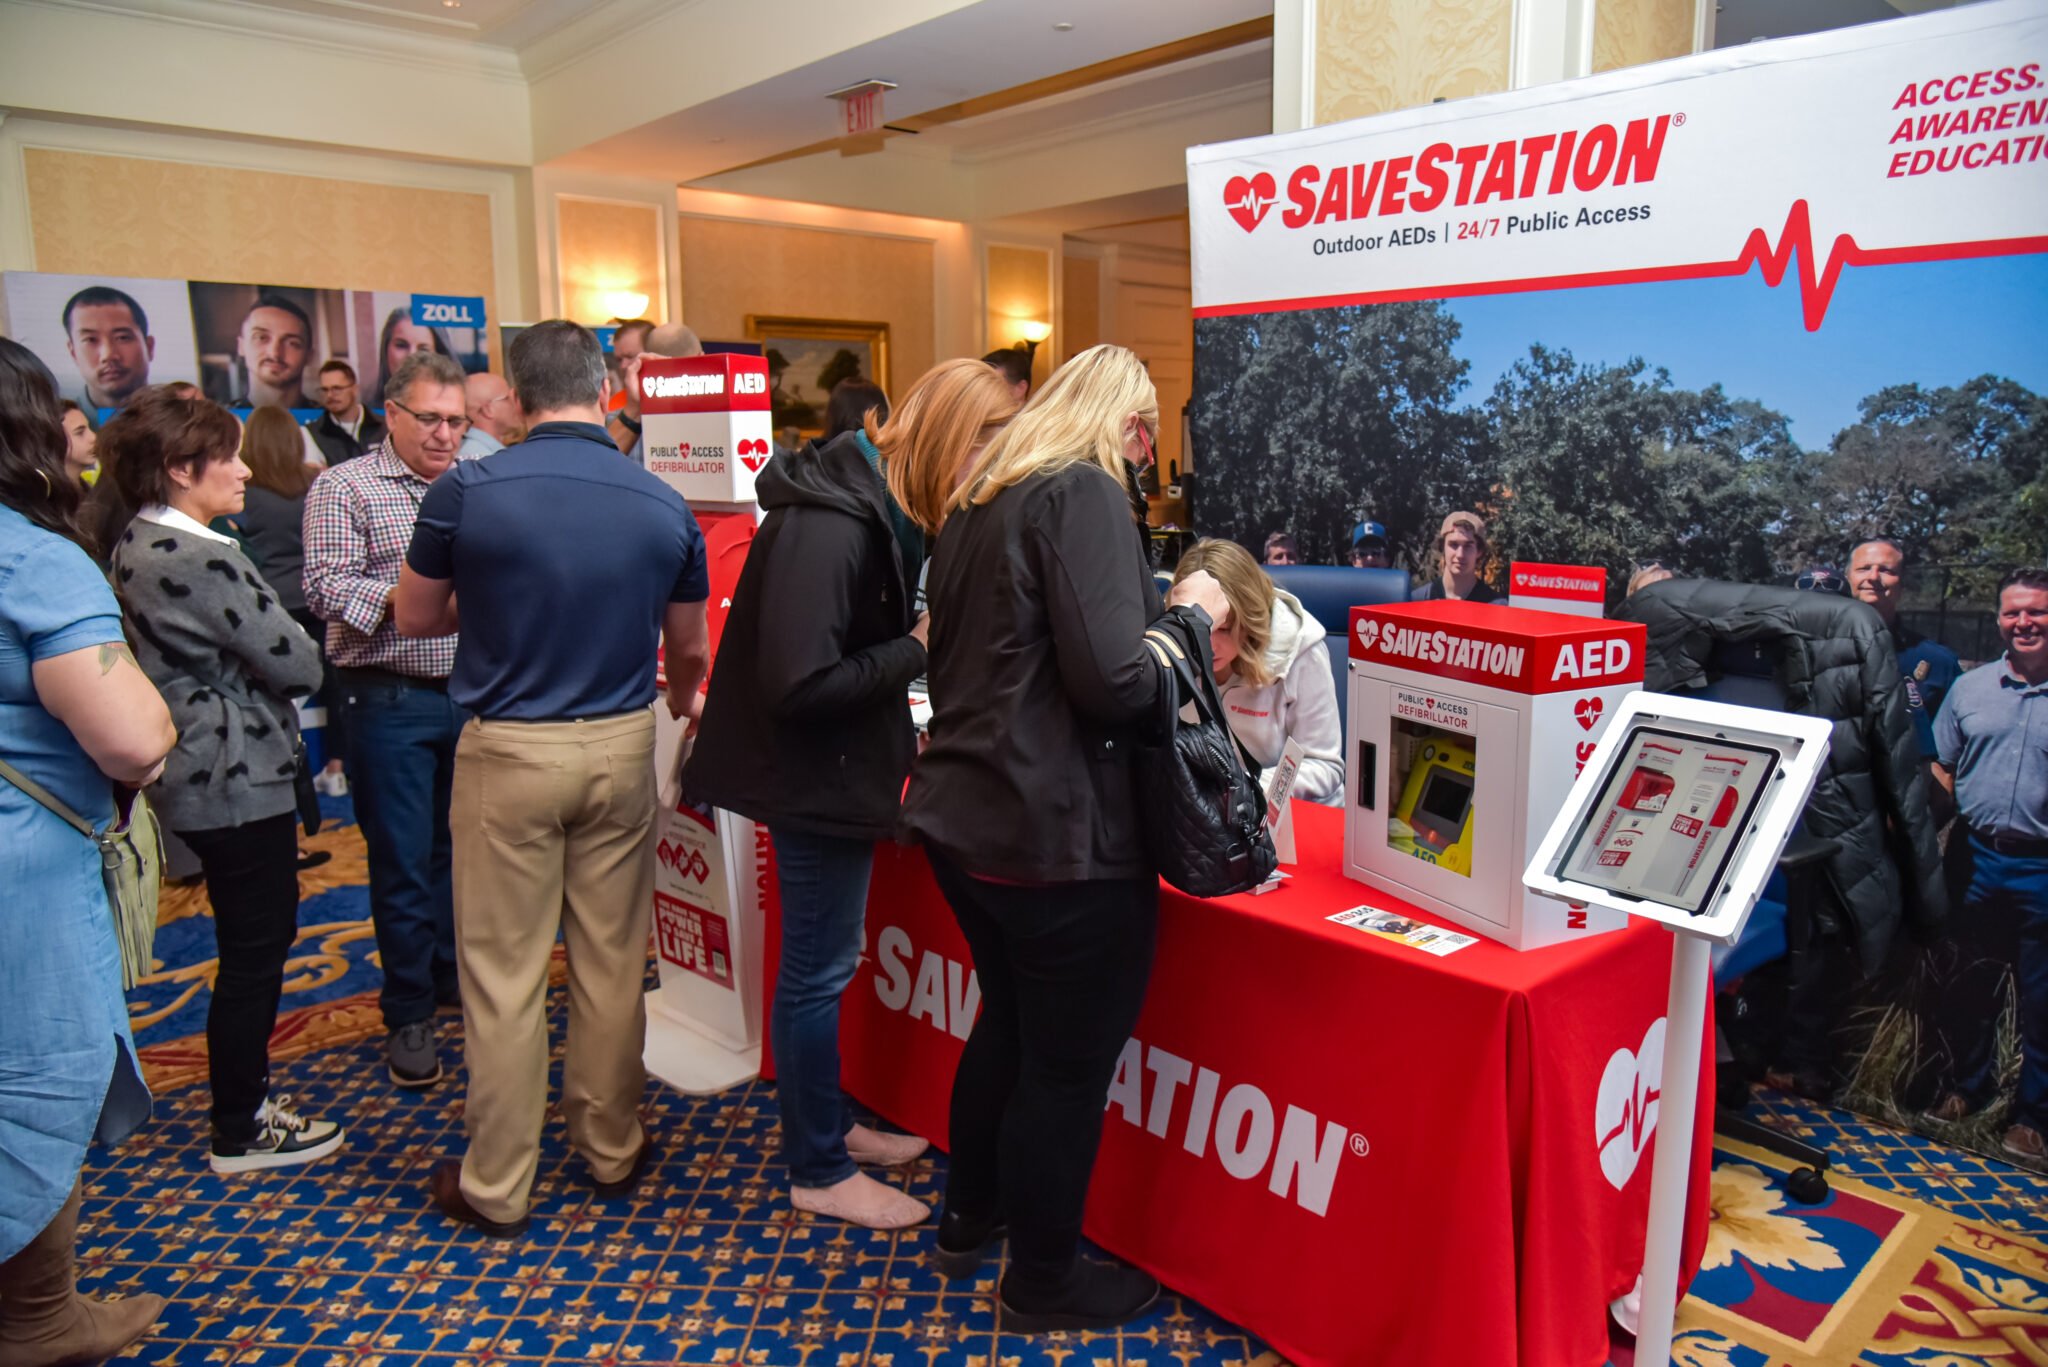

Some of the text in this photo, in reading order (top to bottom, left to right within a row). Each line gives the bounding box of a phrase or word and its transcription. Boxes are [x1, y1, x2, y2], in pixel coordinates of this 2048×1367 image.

[1891, 63, 2045, 110] ACCESS.
[847, 92, 875, 133] EXIT
[1888, 97, 2048, 145] AWAREN
[1313, 235, 1383, 256] Outdoor
[1388, 226, 1436, 248] AEDs
[1457, 218, 1500, 240] 24/7
[1507, 210, 1569, 235] Public
[1575, 204, 1651, 227] Access
[422, 304, 473, 323] ZOLL
[733, 373, 766, 394] AED
[650, 446, 724, 458] PUBLIC ACCESS
[651, 461, 725, 474] DEFIBRILLATOR
[1528, 574, 1600, 592] SAVESTATION
[1379, 622, 1525, 678] SAVESTATION
[1550, 638, 1632, 682] AED
[1398, 692, 1468, 716] PUBLIC ACCESS
[1398, 703, 1468, 729] DEFIBRILLATOR
[661, 932, 709, 975] LIFE
